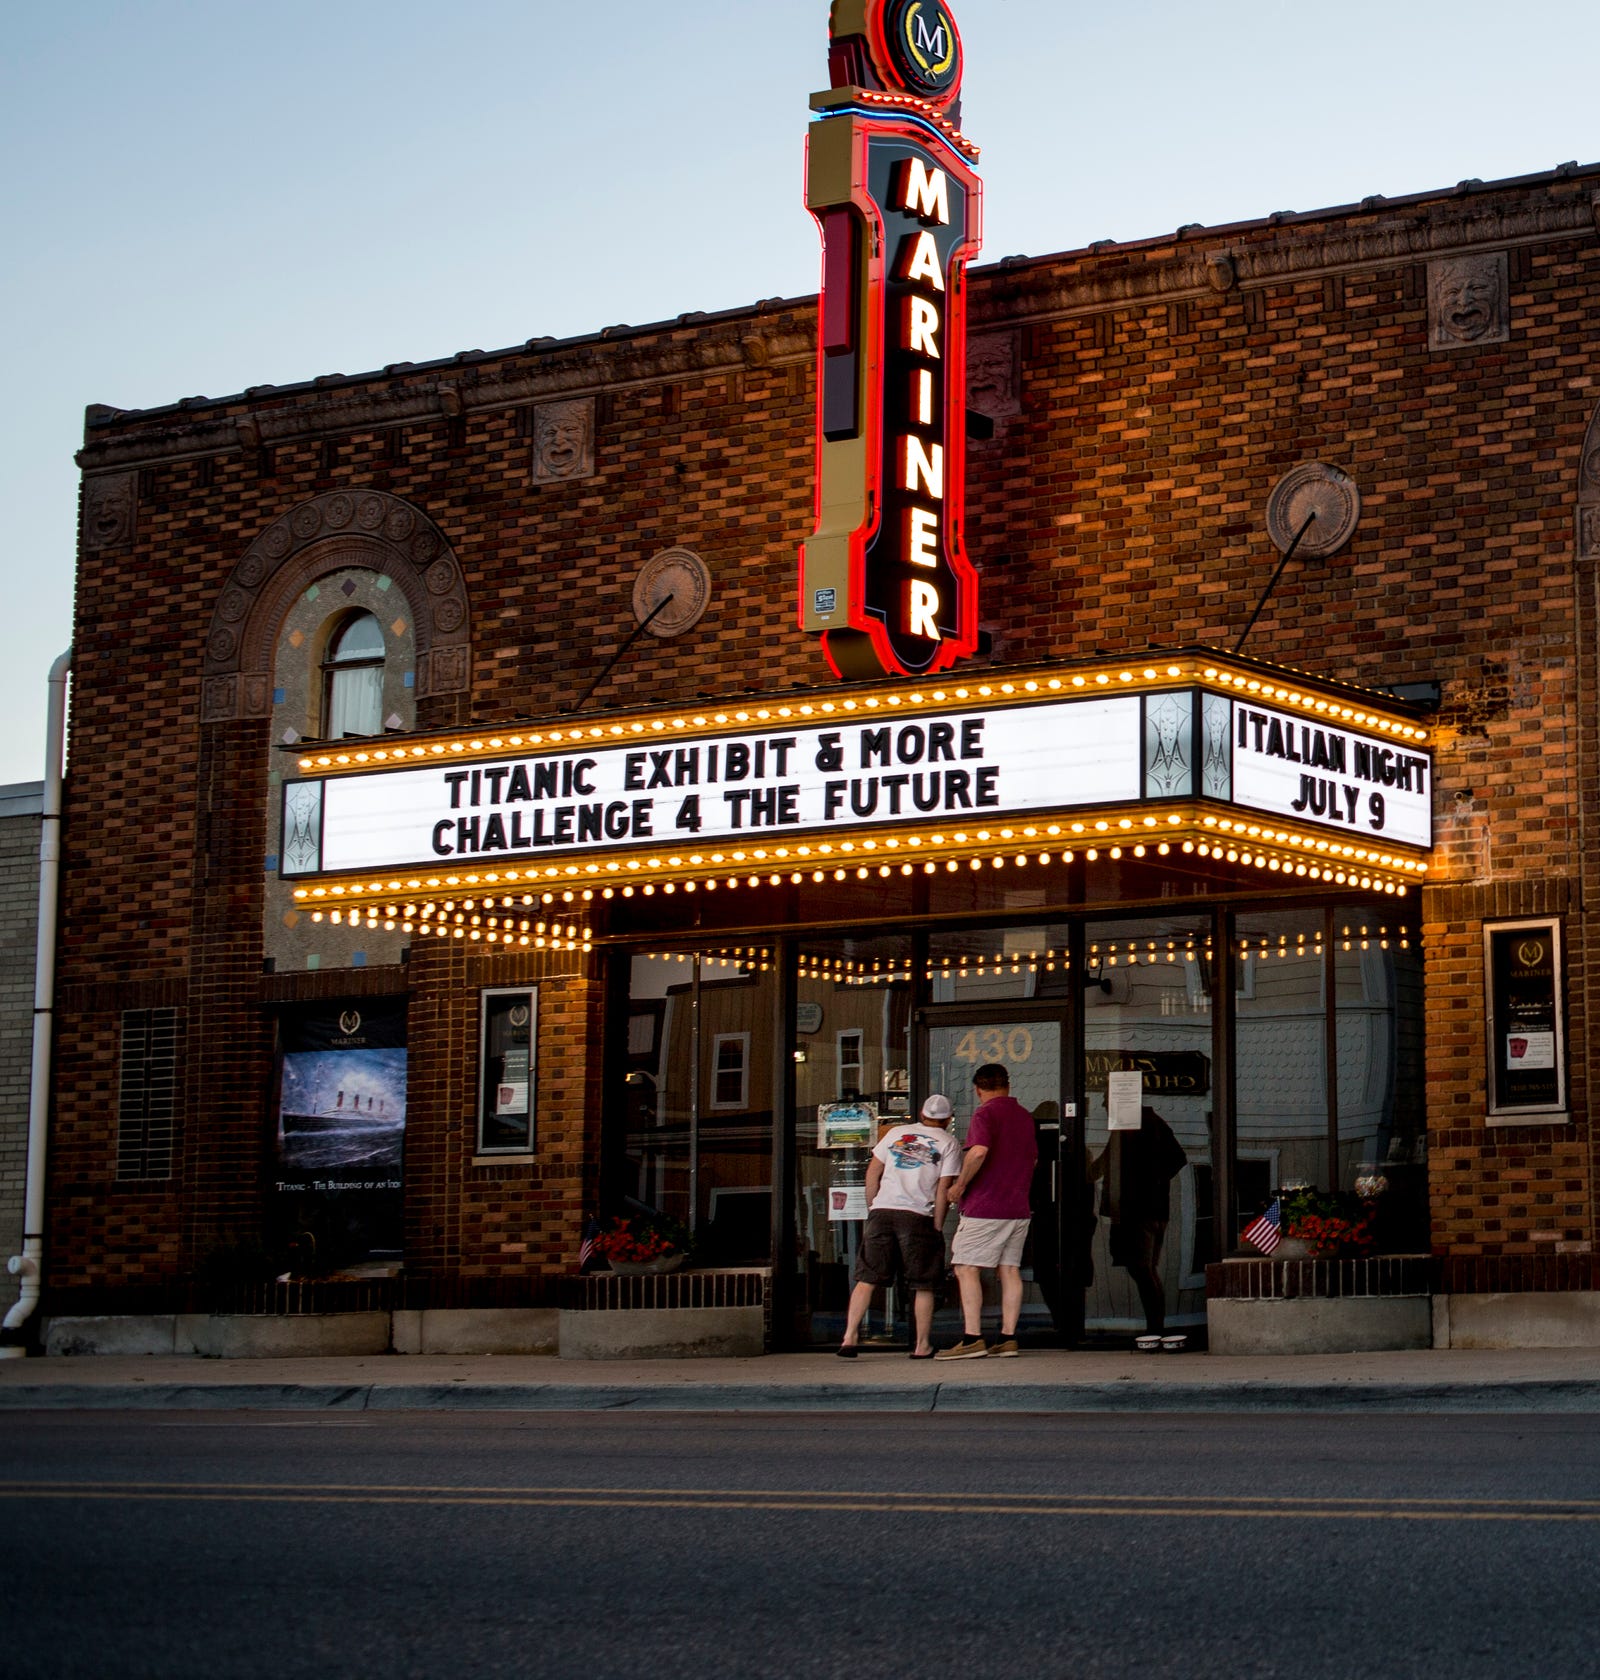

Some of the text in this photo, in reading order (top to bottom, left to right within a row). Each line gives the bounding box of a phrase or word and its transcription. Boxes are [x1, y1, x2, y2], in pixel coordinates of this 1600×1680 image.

[914, 13, 946, 60] M
[904, 156, 950, 641] MARINER
[443, 718, 986, 809] TITANIC EXHIBIT & MORE
[1238, 708, 1429, 795] ITALIAN NIGHT
[432, 766, 1000, 856] CHALLENGE 4 THE FUTURE
[1291, 774, 1386, 830] JULY 9
[956, 1027, 1033, 1064] 430
